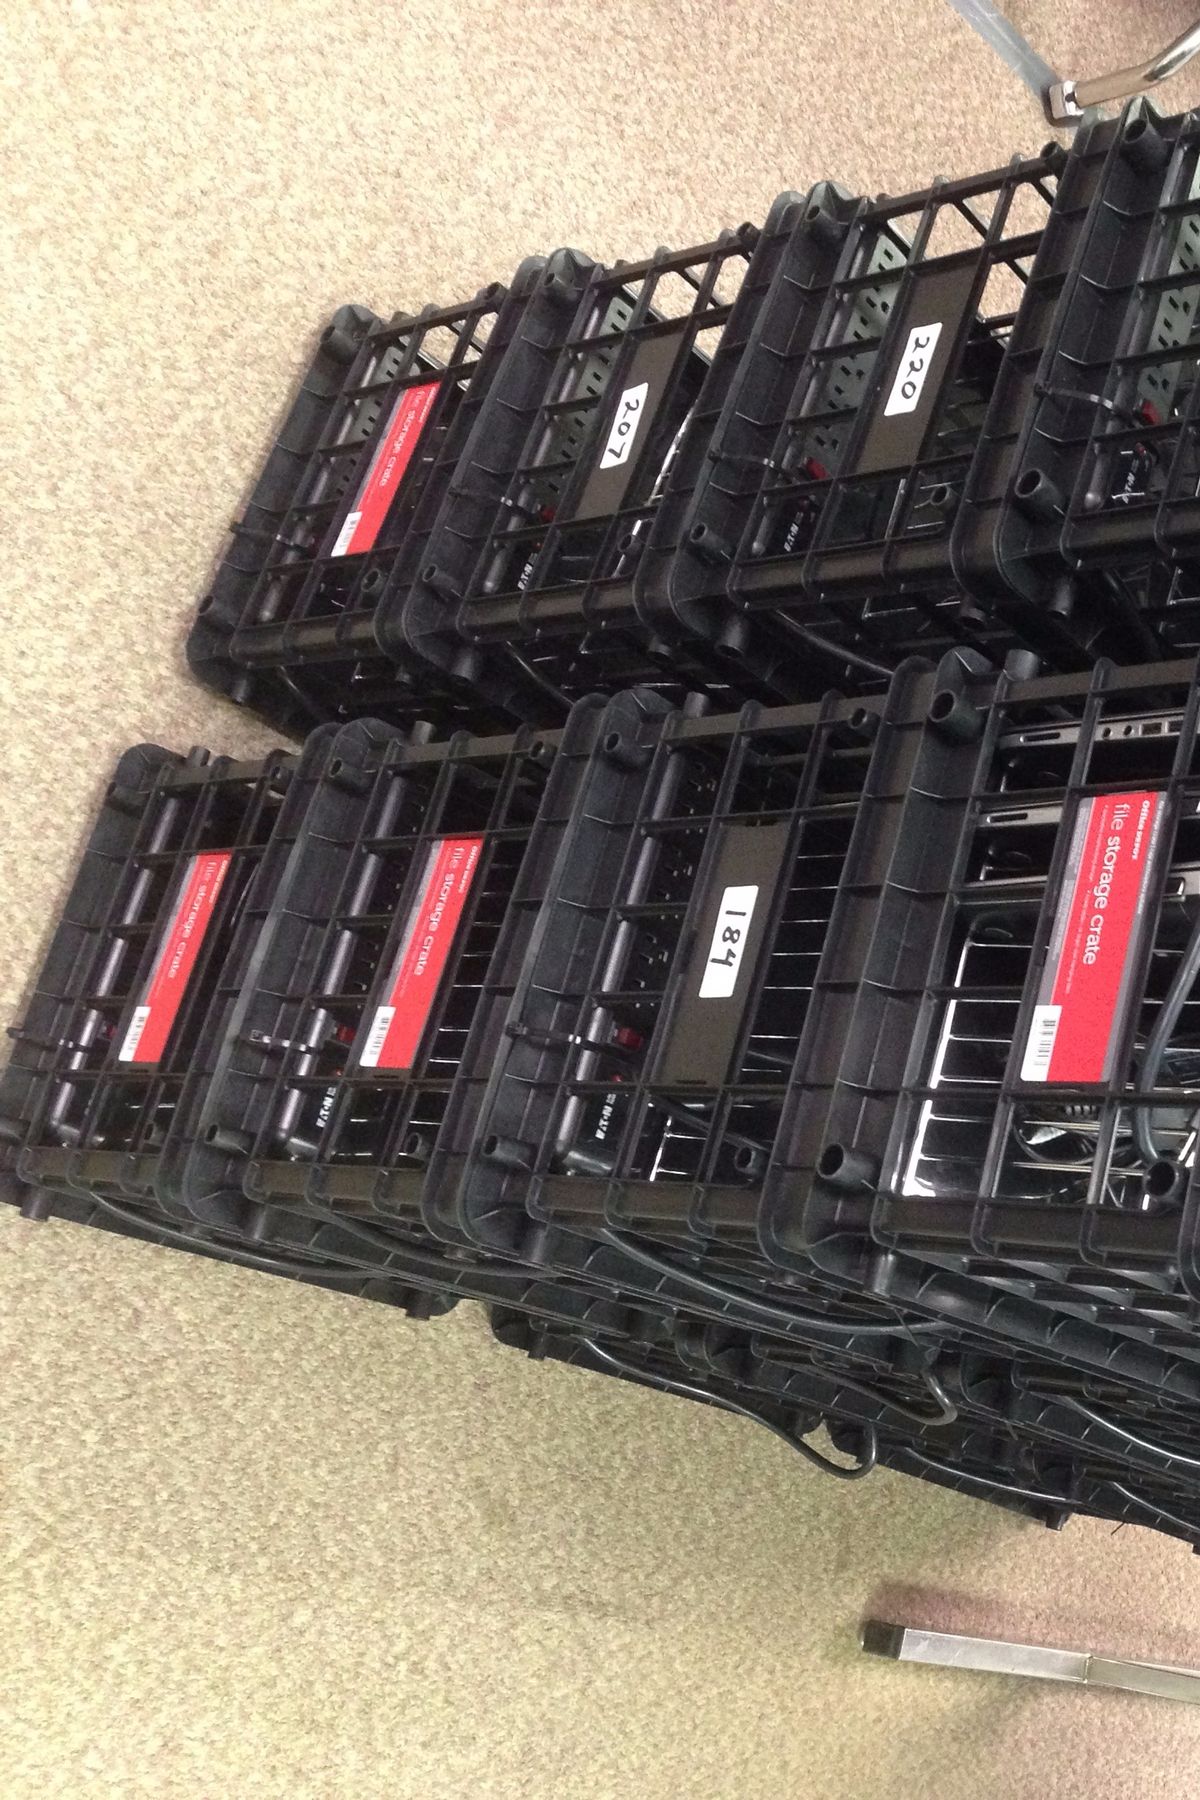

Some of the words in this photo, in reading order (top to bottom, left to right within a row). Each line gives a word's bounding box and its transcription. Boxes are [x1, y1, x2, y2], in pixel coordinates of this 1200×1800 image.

[900, 336, 930, 399] 220
[411, 391, 425, 407] file
[391, 410, 416, 454] storage
[607, 399, 640, 458] 207
[379, 456, 397, 487] crate
[1110, 803, 1130, 831] file
[204, 861, 217, 882] file
[448, 847, 464, 869] file
[1093, 836, 1121, 909] storage
[181, 885, 207, 938] storage
[429, 873, 455, 932] storage
[168, 941, 188, 979] crate
[413, 935, 436, 976] crate
[710, 910, 746, 968] 184
[1082, 914, 1104, 964] crate
